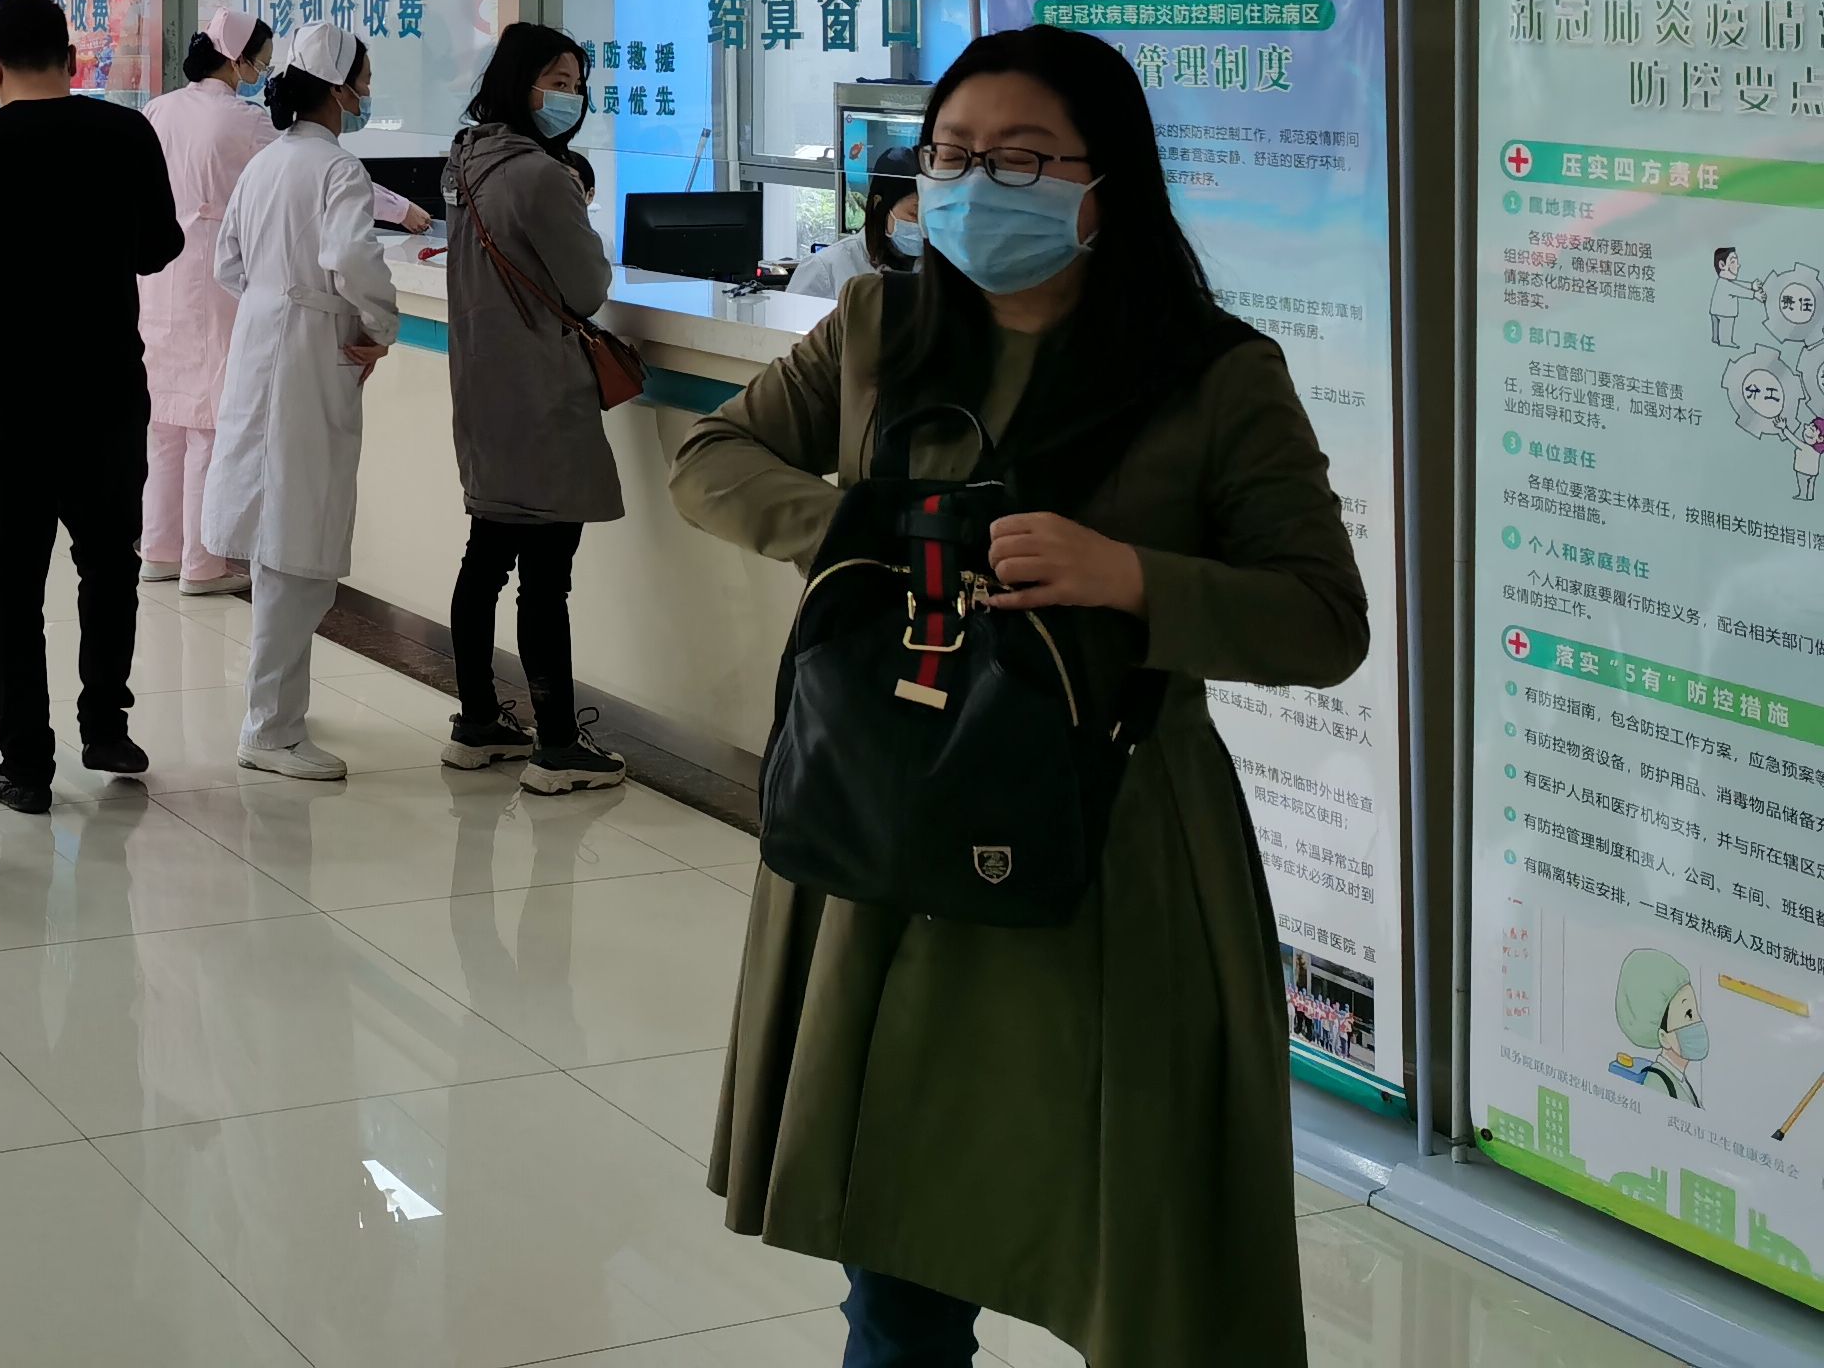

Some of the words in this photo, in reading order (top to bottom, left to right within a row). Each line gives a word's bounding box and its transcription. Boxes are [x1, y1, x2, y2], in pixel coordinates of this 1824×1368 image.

[1042, 2, 1321, 26] 新型冠状病毒肺炎防控期间住院病区
[1117, 42, 1294, 93] 管理制度
[1628, 59, 1824, 118] 防控要点
[1560, 150, 1721, 191] 压实四方责任
[1528, 195, 1595, 221] 属地责任
[1527, 229, 1654, 261] 各级党委政府要加强
[1503, 289, 1551, 311] 地落实。
[1528, 326, 1597, 354] 部门责任
[1309, 384, 1367, 408] 主动出示
[1503, 397, 1608, 432] 业的指导和支持。
[1528, 439, 1598, 470] 单位责任
[1503, 488, 1608, 526] 好各项防控措施。
[1528, 535, 1651, 581] 个人和家庭责任
[1502, 583, 1594, 621] 疫情防控工作。
